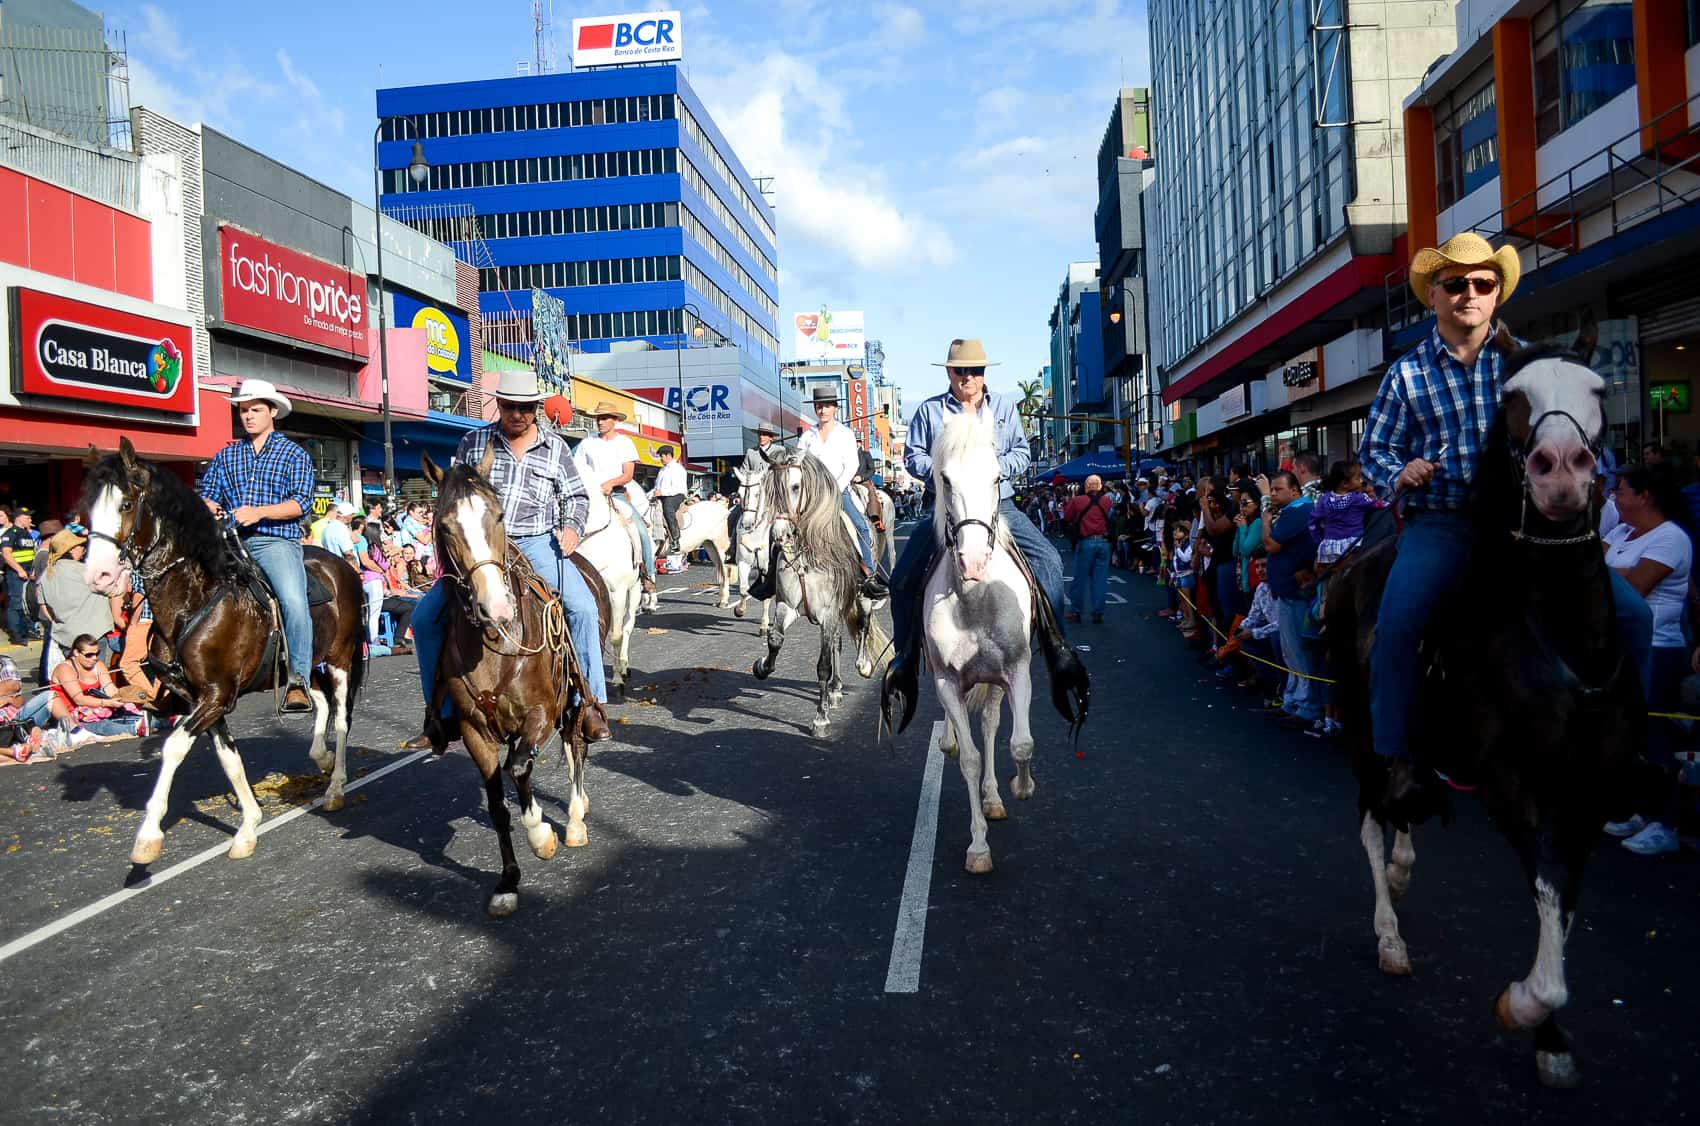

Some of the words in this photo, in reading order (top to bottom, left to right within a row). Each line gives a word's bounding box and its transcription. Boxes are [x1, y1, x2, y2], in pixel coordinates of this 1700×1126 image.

[615, 20, 674, 47] BCR
[644, 46, 661, 54] Costa
[44, 339, 88, 369] Casa
[90, 347, 148, 379] Blanca
[668, 385, 729, 411] BCR
